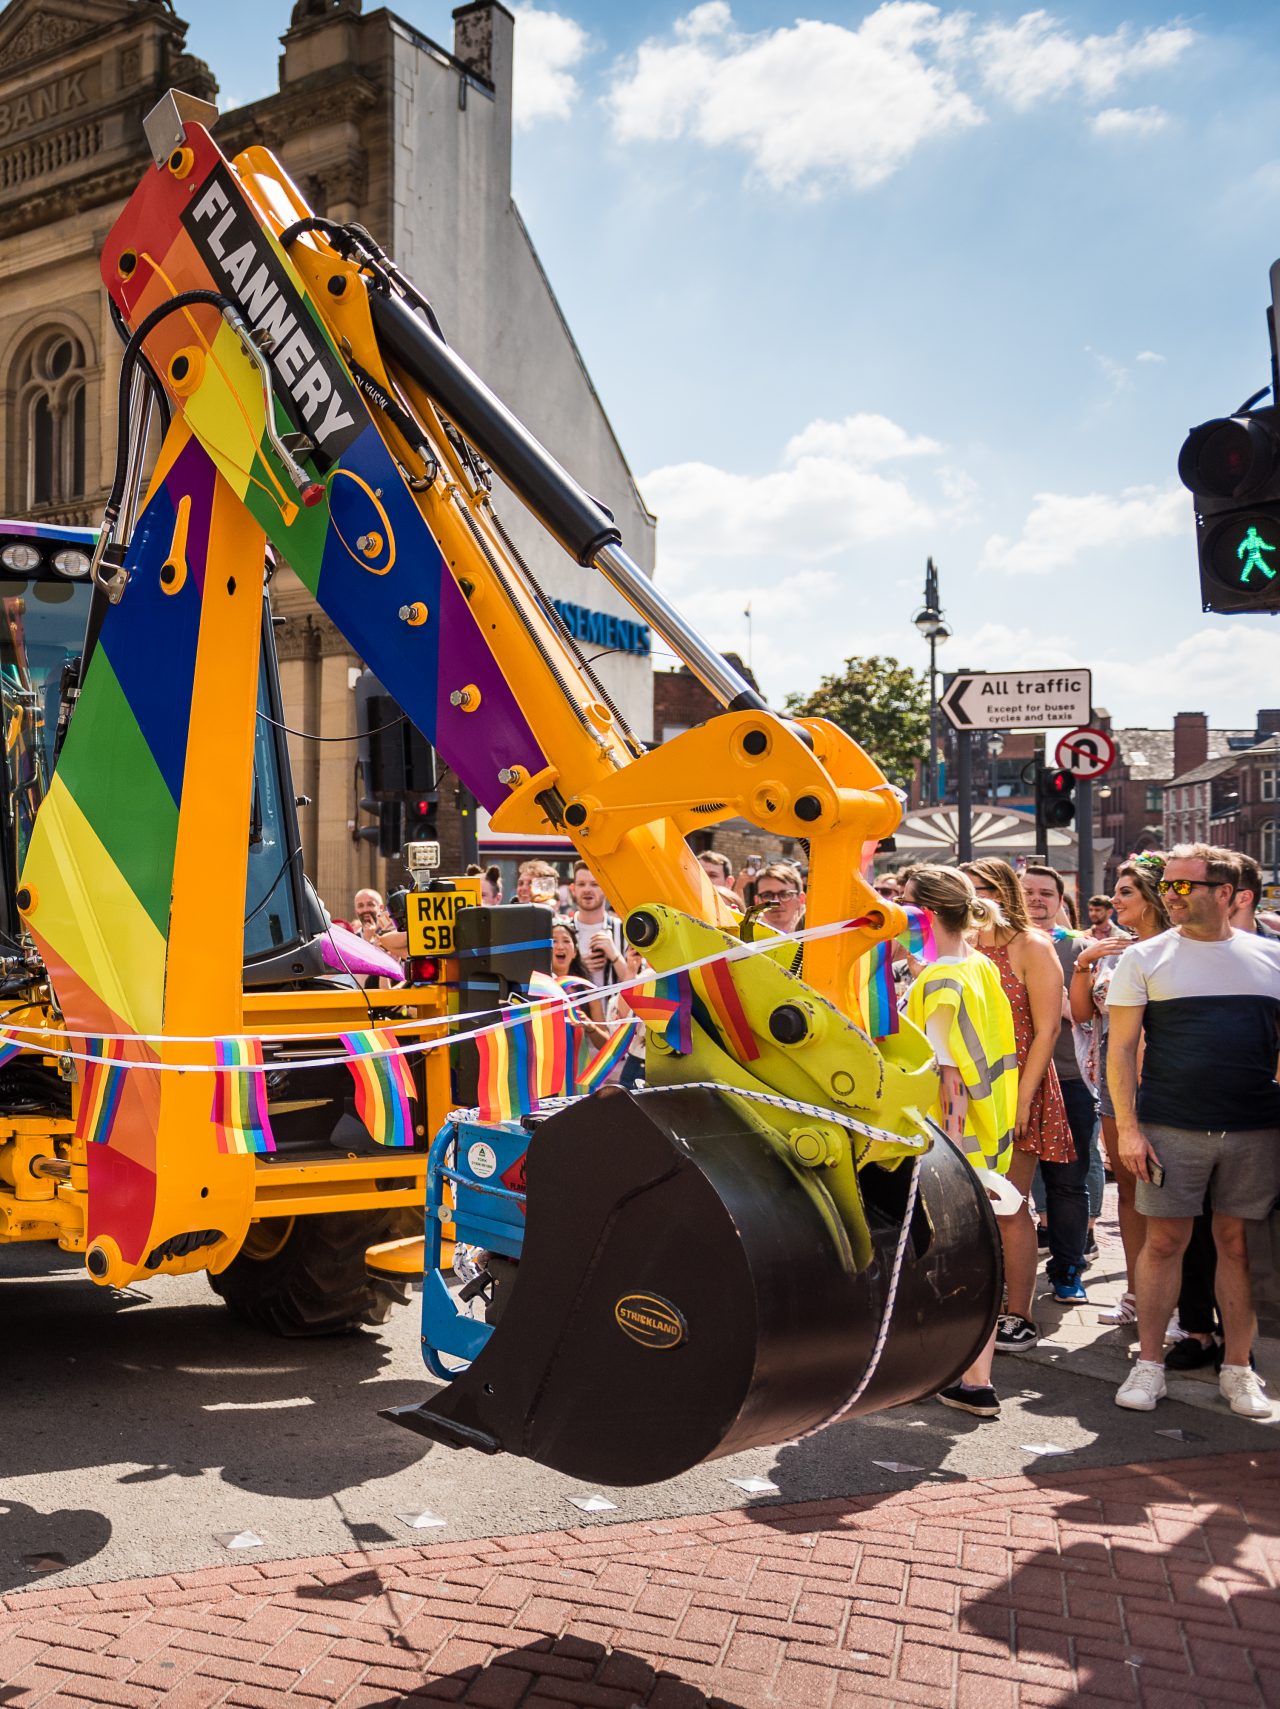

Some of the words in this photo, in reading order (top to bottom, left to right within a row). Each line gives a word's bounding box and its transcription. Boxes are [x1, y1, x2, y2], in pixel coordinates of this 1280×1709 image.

[192, 180, 354, 444] FLANNERY
[981, 681, 1009, 696] All
[1016, 678, 1082, 695] traffic
[986, 705, 1023, 714] Except
[1026, 703, 1041, 712] for
[1044, 703, 1076, 712] buses
[988, 714, 1021, 724] cycles
[1024, 713, 1044, 722] and
[1046, 712, 1073, 721] taxis
[422, 925, 456, 950] SB
[620, 1308, 678, 1336] STRICKLAND
